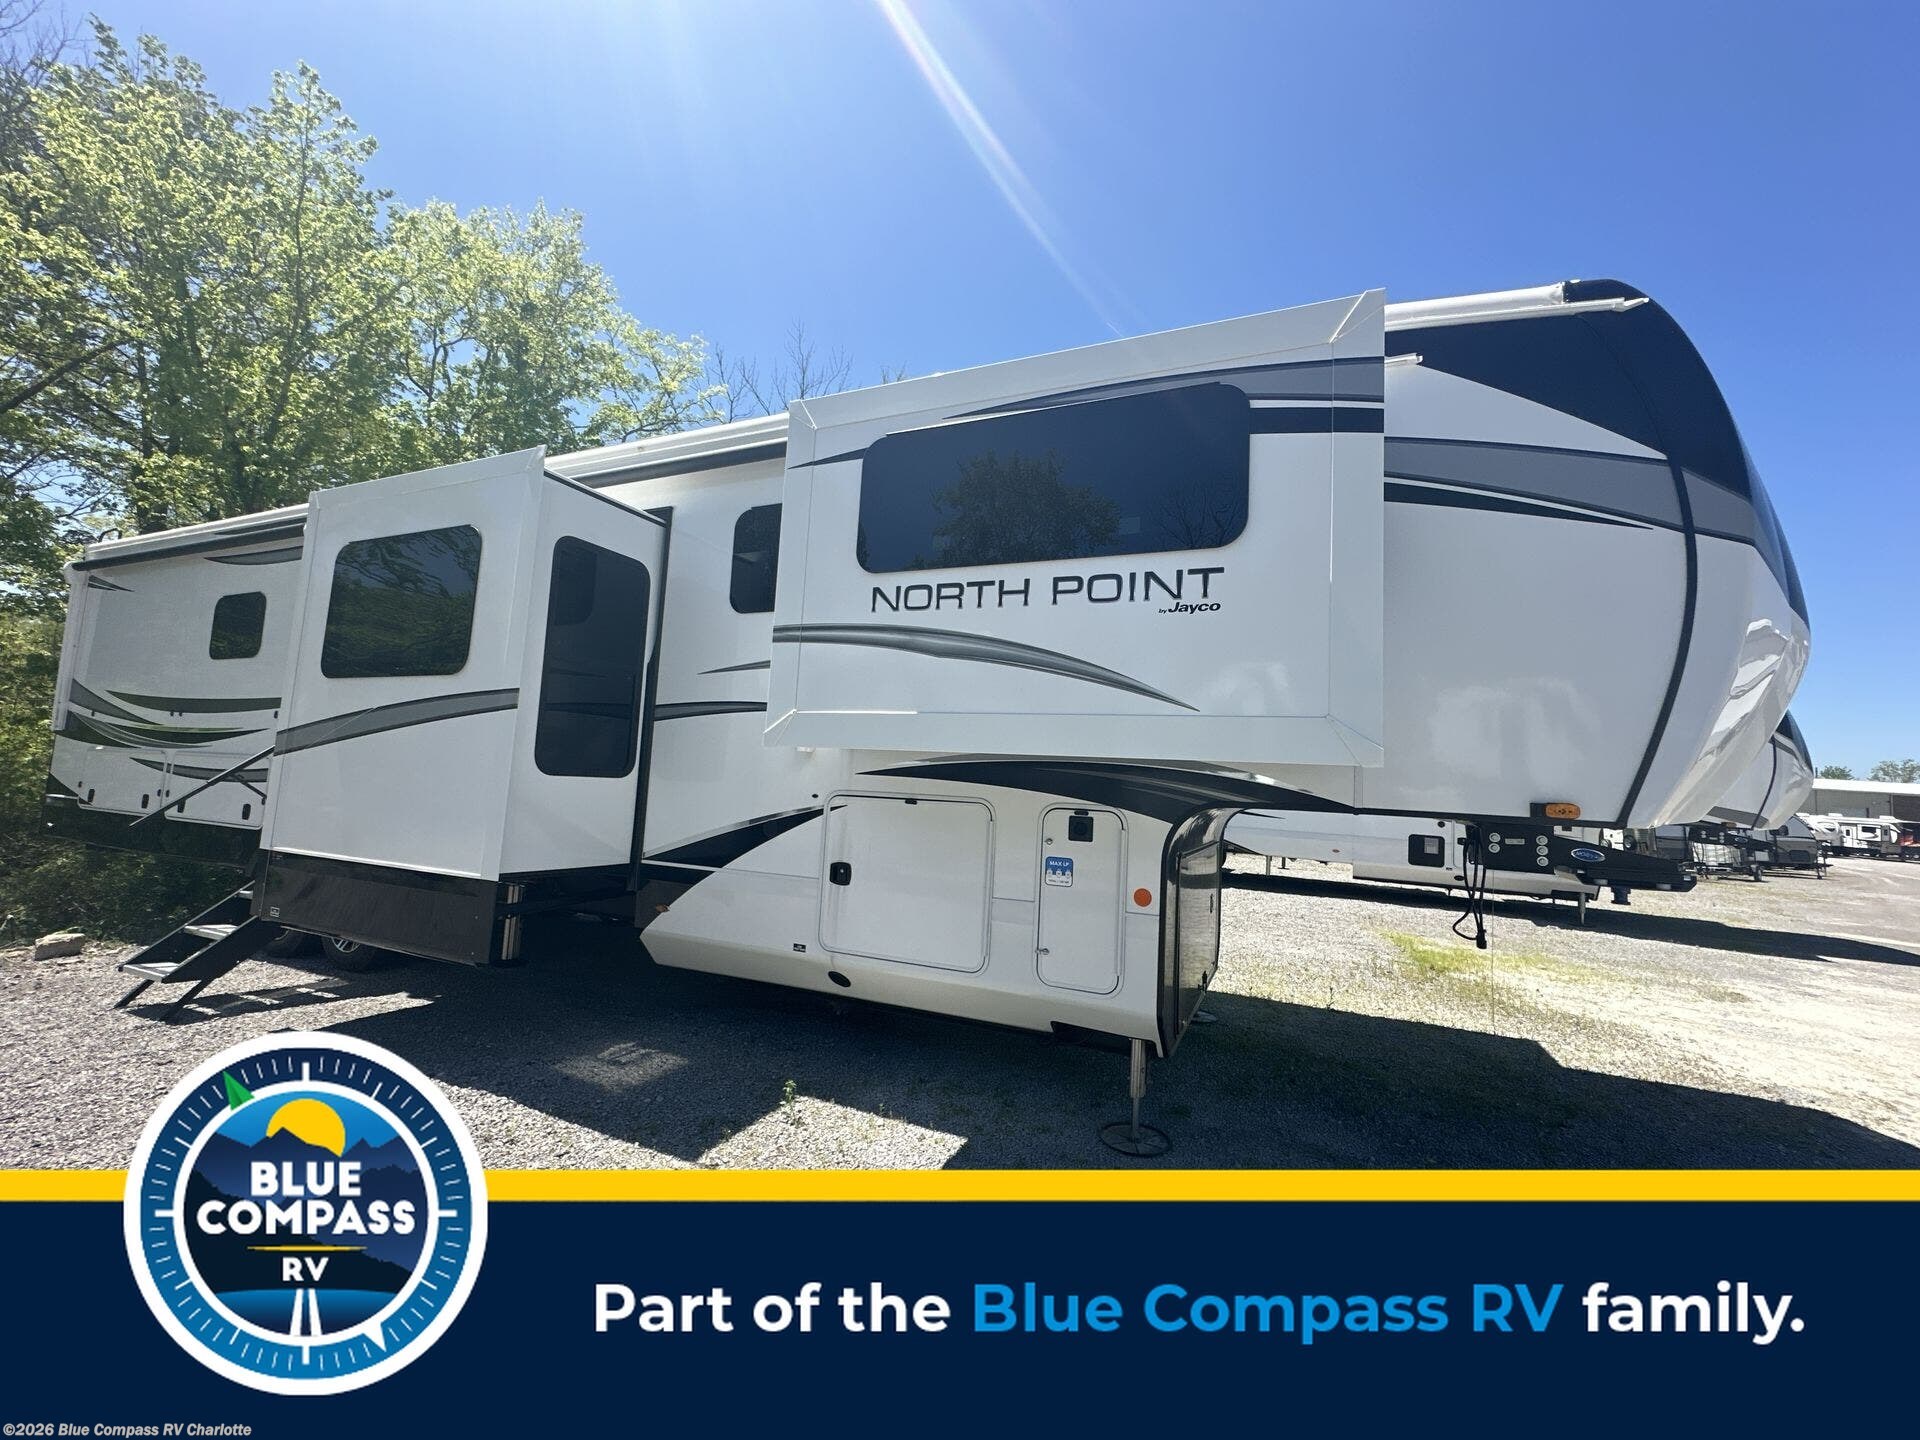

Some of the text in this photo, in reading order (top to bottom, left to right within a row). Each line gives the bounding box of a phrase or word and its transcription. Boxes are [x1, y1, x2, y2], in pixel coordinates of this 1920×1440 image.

[871, 566, 1225, 613] NORTH POINT
[1168, 601, 1222, 615] Jayco
